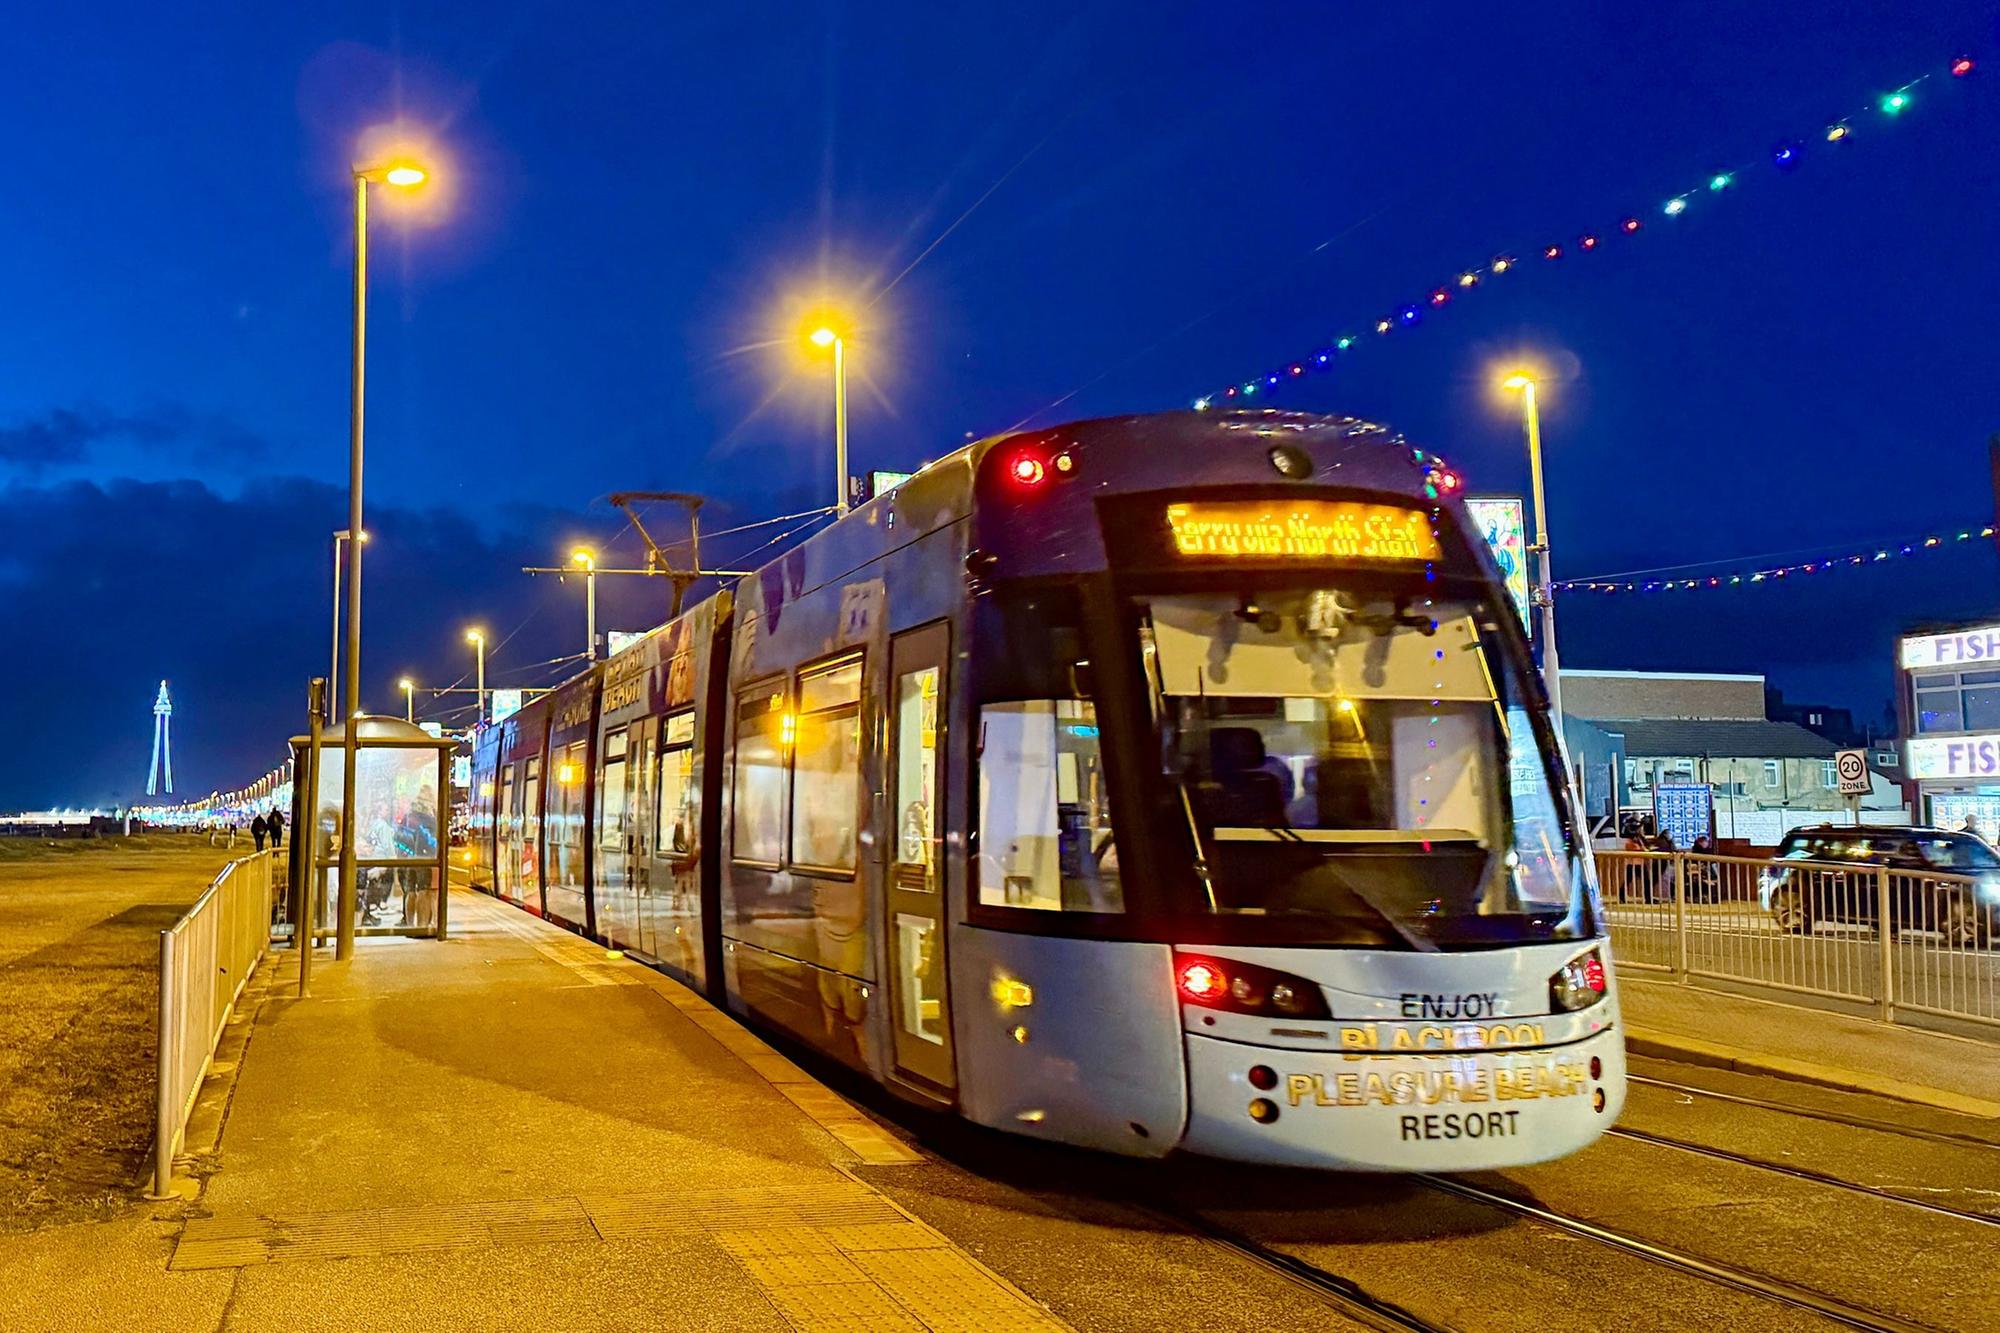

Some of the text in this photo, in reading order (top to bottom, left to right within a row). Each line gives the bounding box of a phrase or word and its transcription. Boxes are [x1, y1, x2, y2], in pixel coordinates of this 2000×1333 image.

[1842, 761, 1860, 773] 20
[1947, 740, 2000, 775] FIS
[1841, 781, 1867, 790] ZONE
[1401, 992, 1497, 1019] ENJOY
[1341, 1023, 1550, 1060] BLACKPOOL
[1288, 1063, 1587, 1106] PLEASURE BEACH
[1400, 1110, 1520, 1142] RESORT
